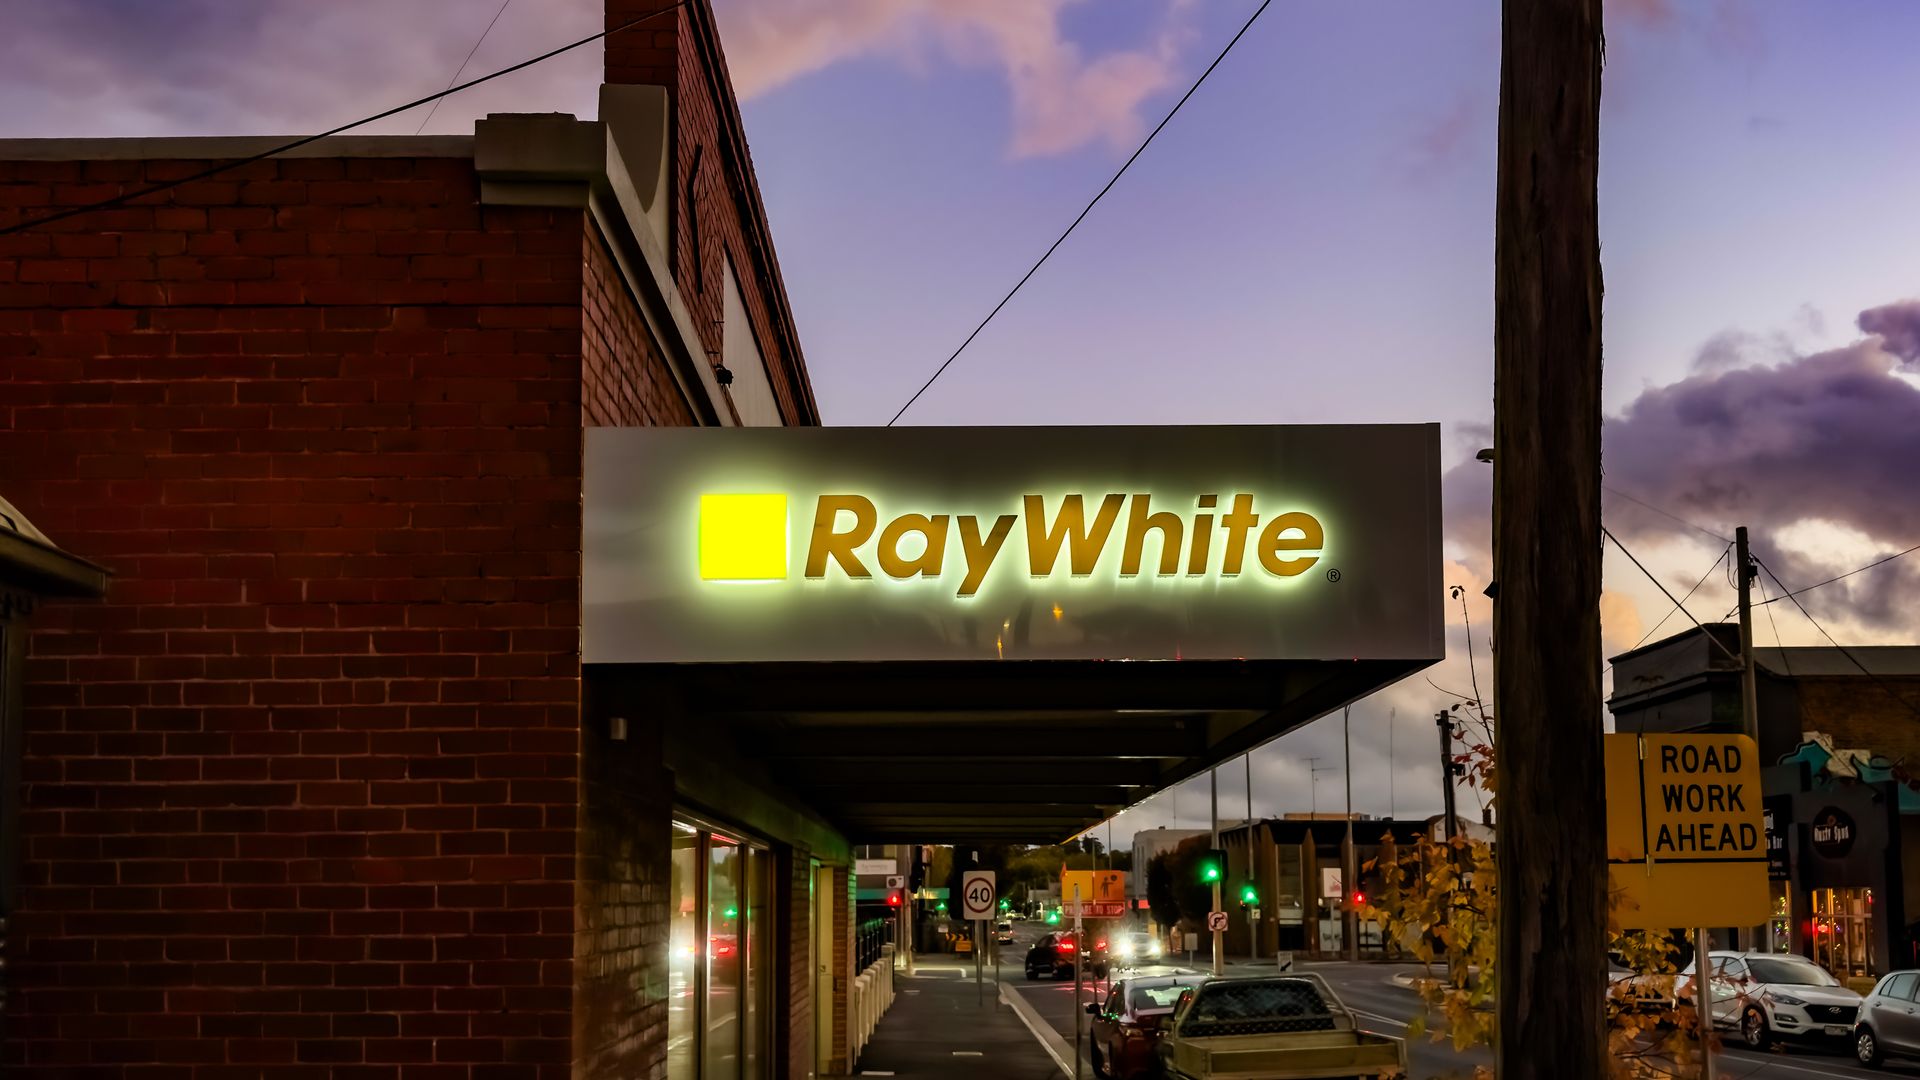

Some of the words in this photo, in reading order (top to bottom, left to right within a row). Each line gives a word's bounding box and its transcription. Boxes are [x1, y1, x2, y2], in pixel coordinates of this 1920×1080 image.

[1661, 744, 1742, 773] ROAD
[1661, 784, 1746, 813] WORK
[1655, 823, 1757, 852] AHEAD
[969, 887, 990, 903] 40
